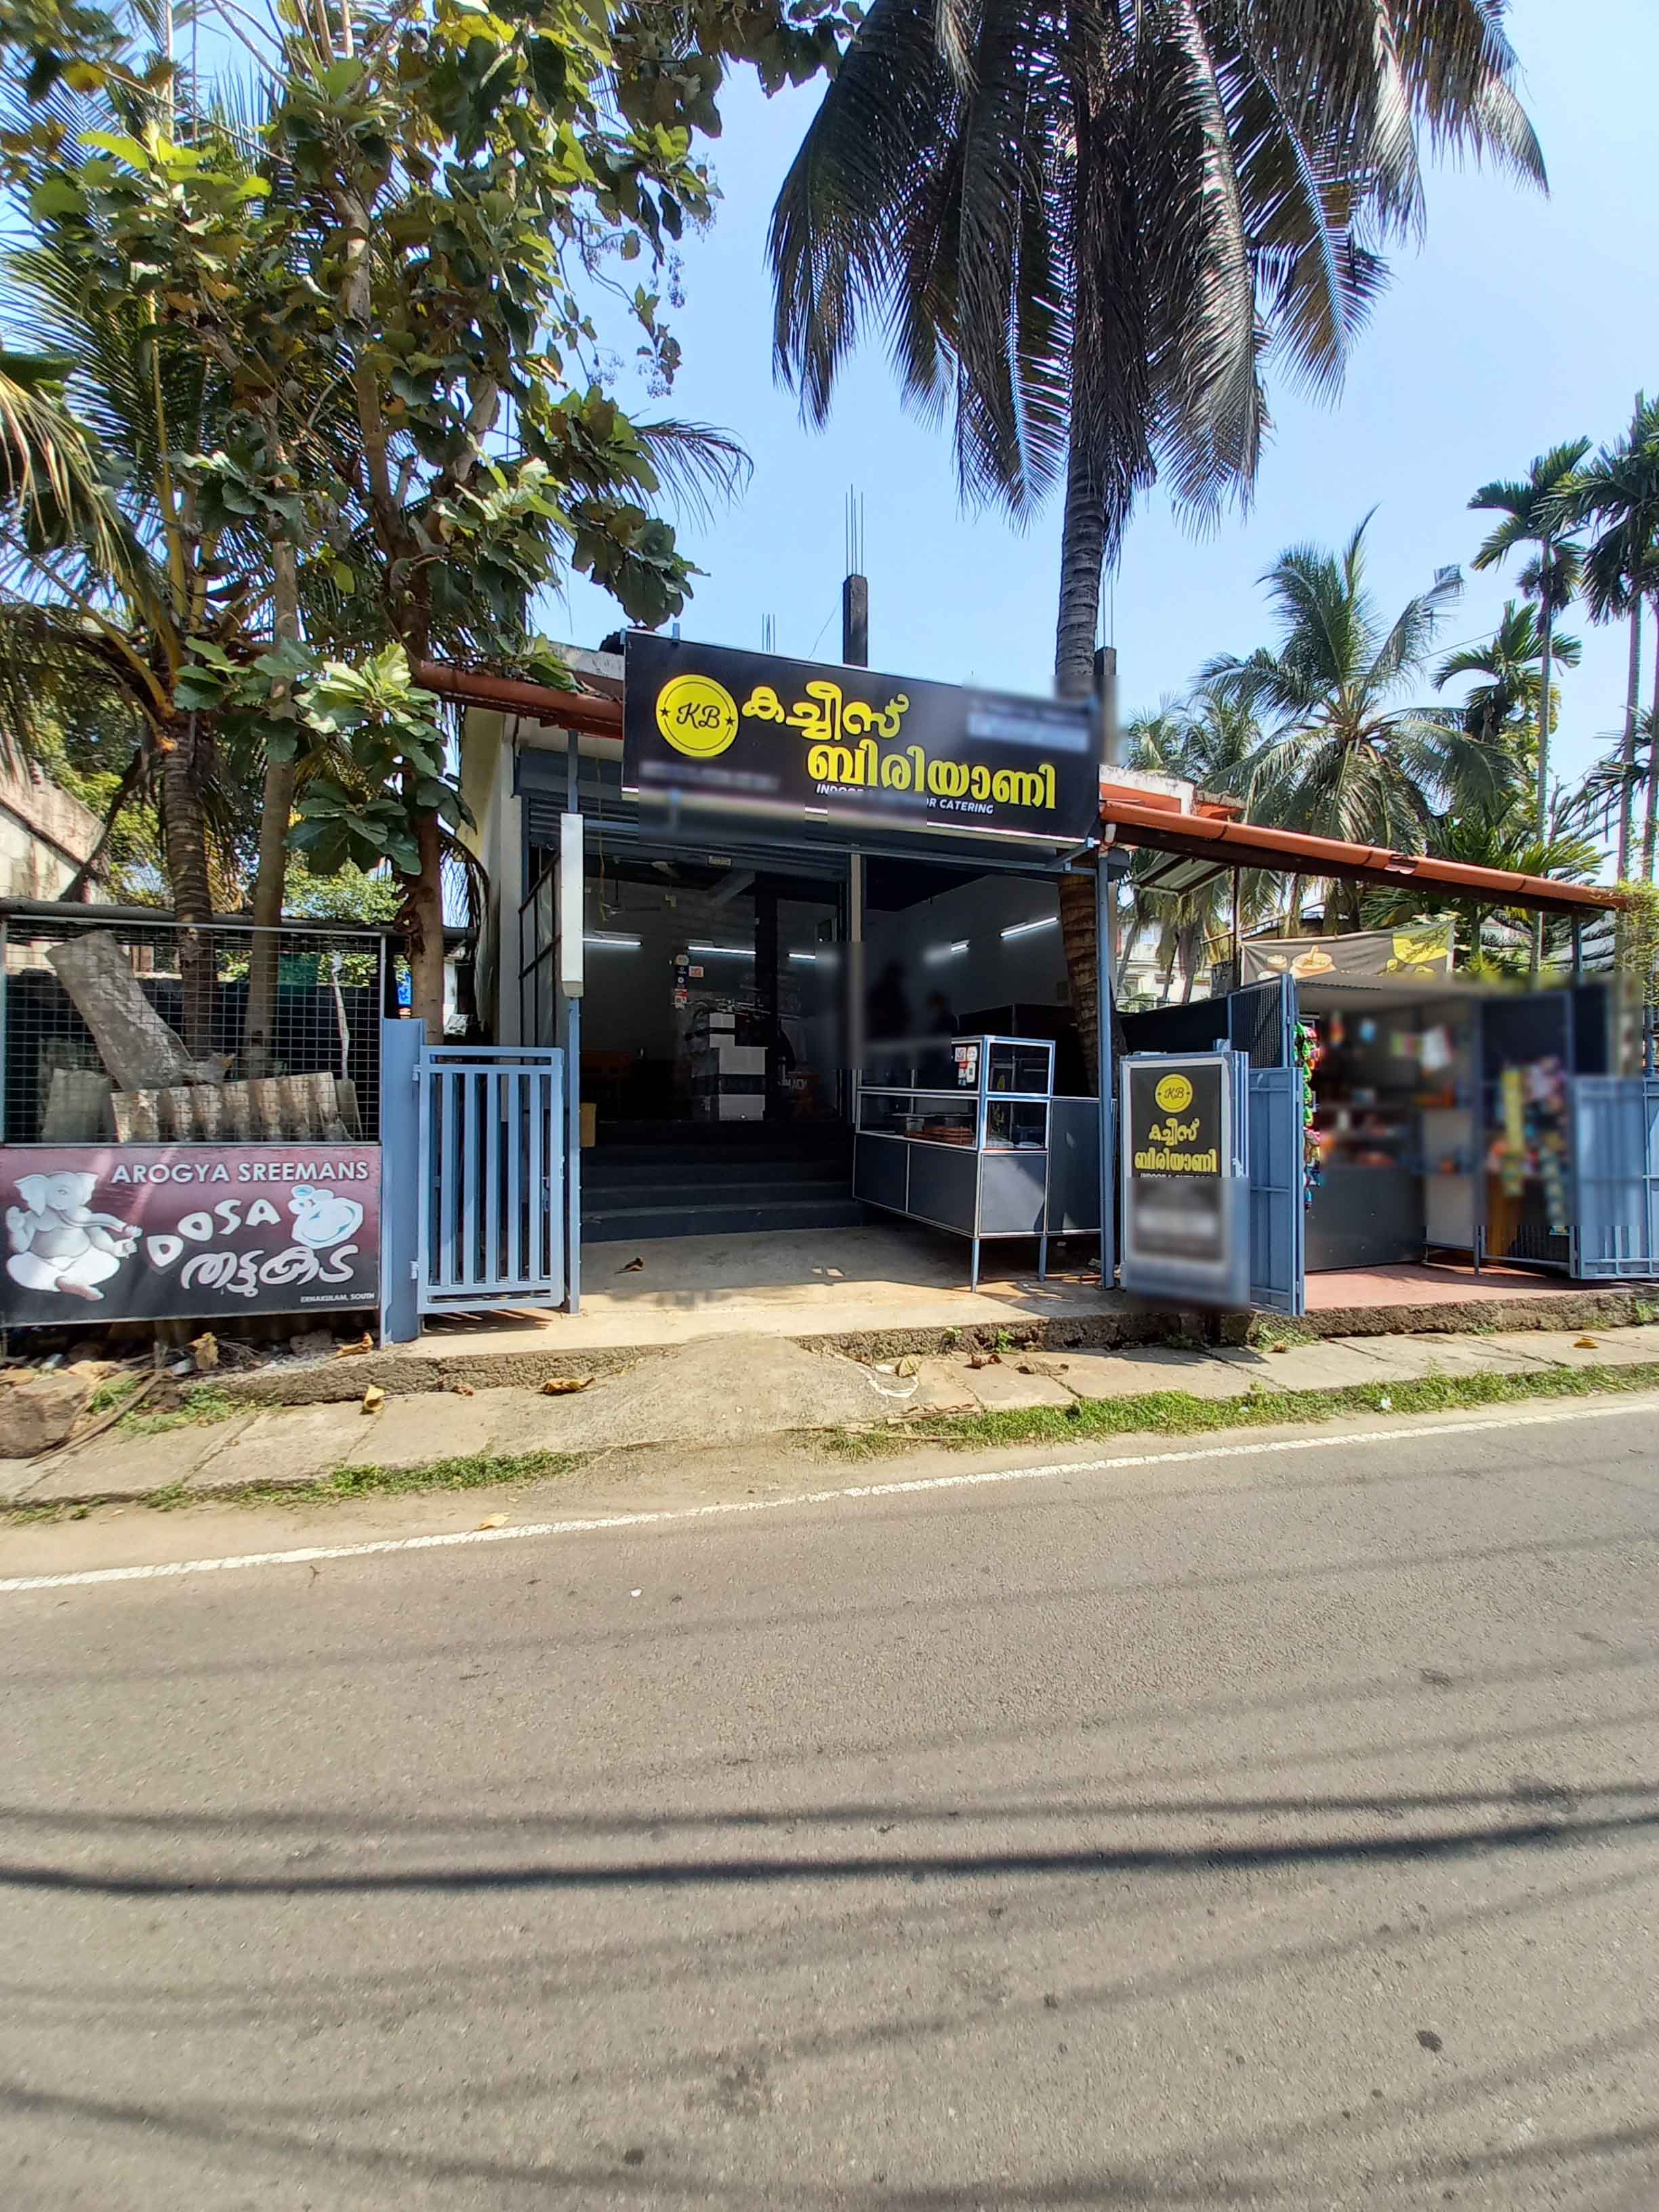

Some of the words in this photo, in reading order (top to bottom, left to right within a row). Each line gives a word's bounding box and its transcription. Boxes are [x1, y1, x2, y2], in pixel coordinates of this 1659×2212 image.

[676, 701, 720, 730] KB
[807, 740, 1057, 810] ബിരിയാണി
[940, 799, 994, 814] CATERING
[1164, 1088, 1185, 1099] KB
[1134, 1147, 1217, 1172] ബിരിയാണി
[110, 1163, 230, 1184] AROGYA
[239, 1162, 369, 1183] SREEMANS
[146, 1199, 282, 1267] DOSA
